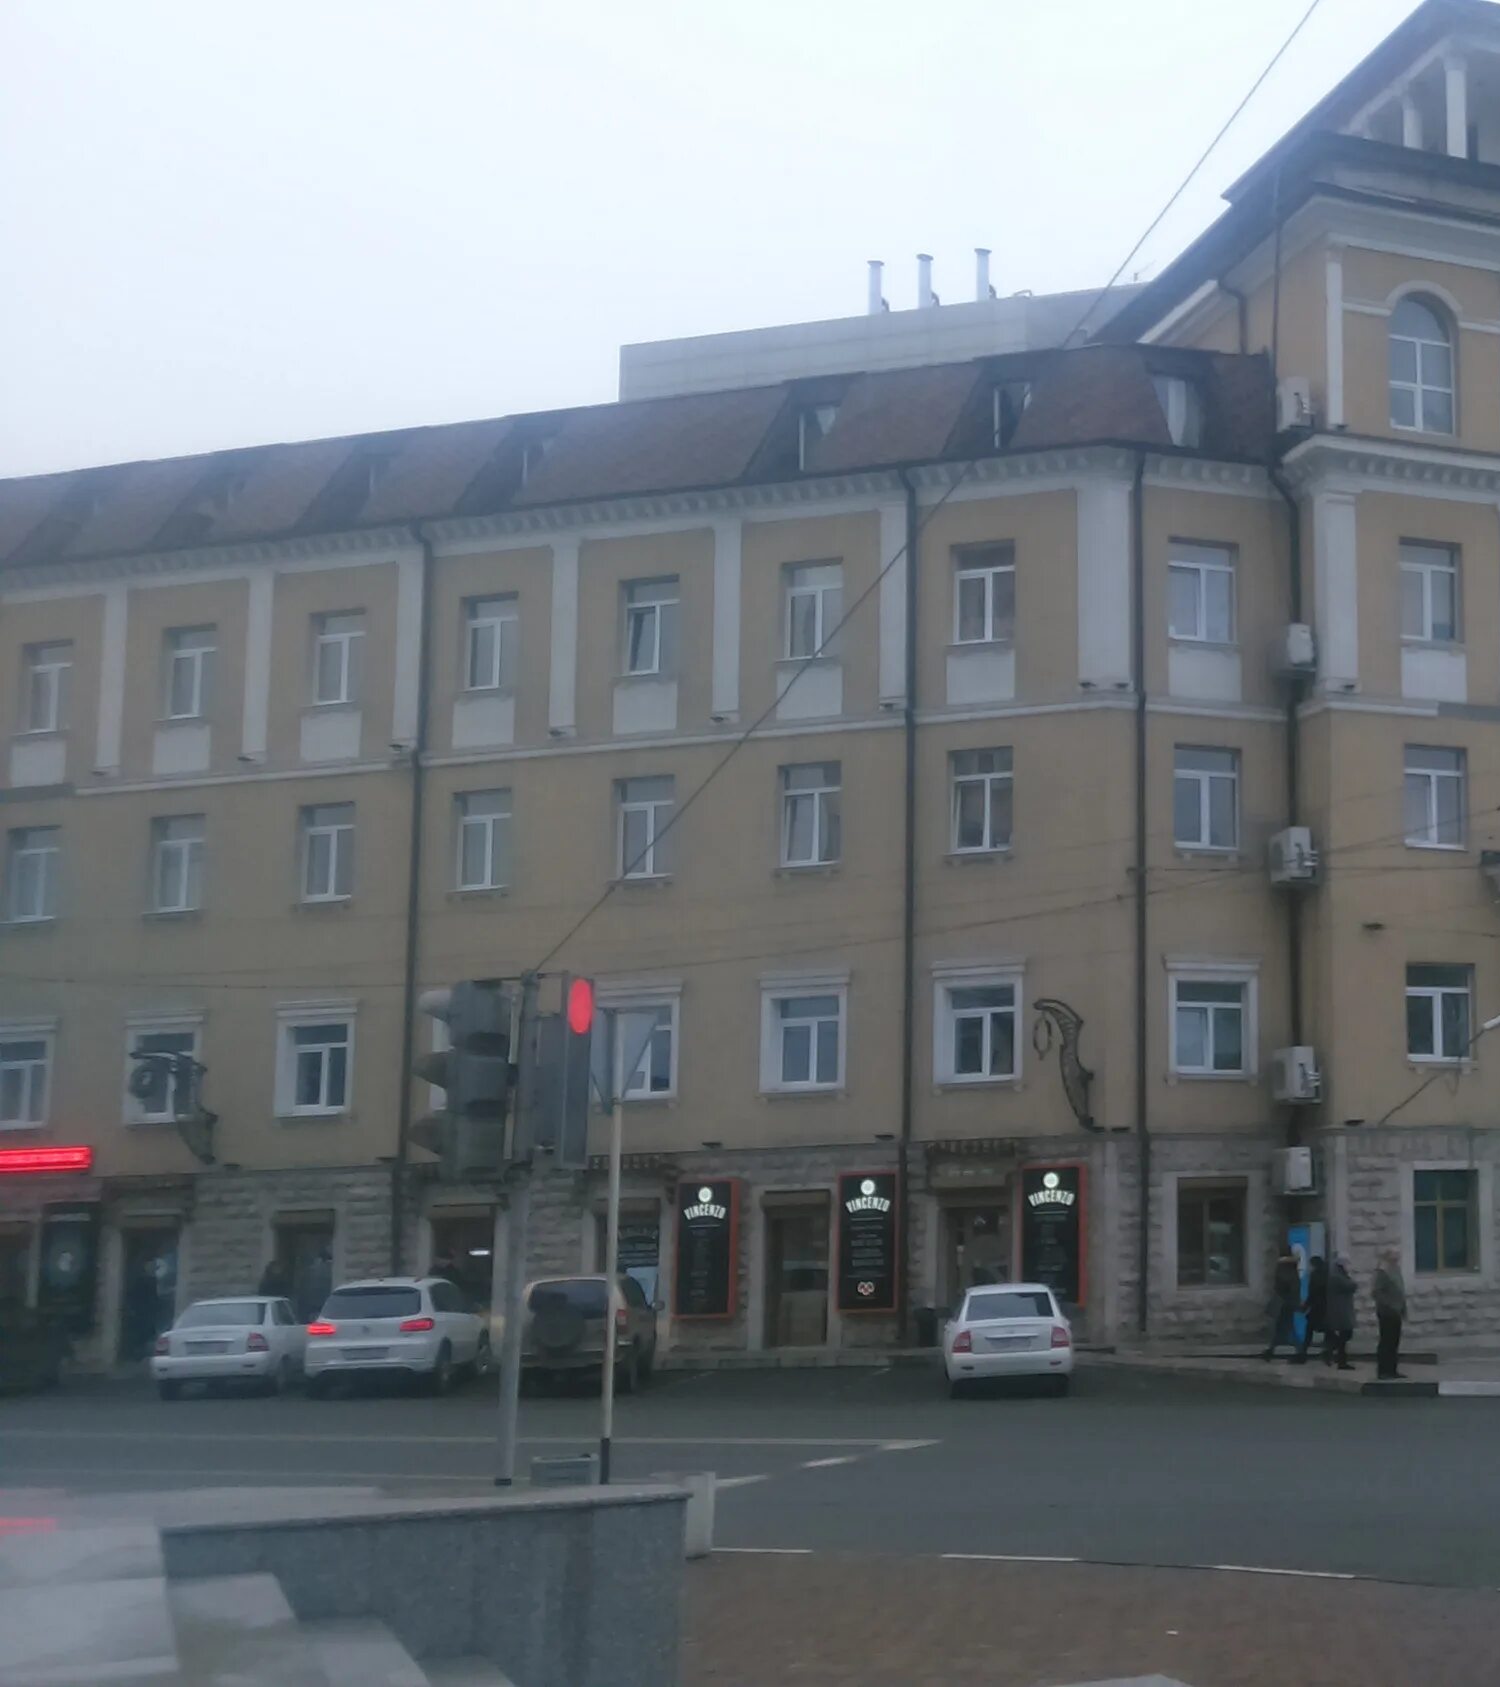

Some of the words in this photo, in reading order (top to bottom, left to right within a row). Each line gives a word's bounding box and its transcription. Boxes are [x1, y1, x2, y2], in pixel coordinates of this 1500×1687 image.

[845, 1196, 891, 1213] VINCENZO
[1028, 1189, 1075, 1207] VINCENZO
[683, 1203, 726, 1220] VINCENZO
